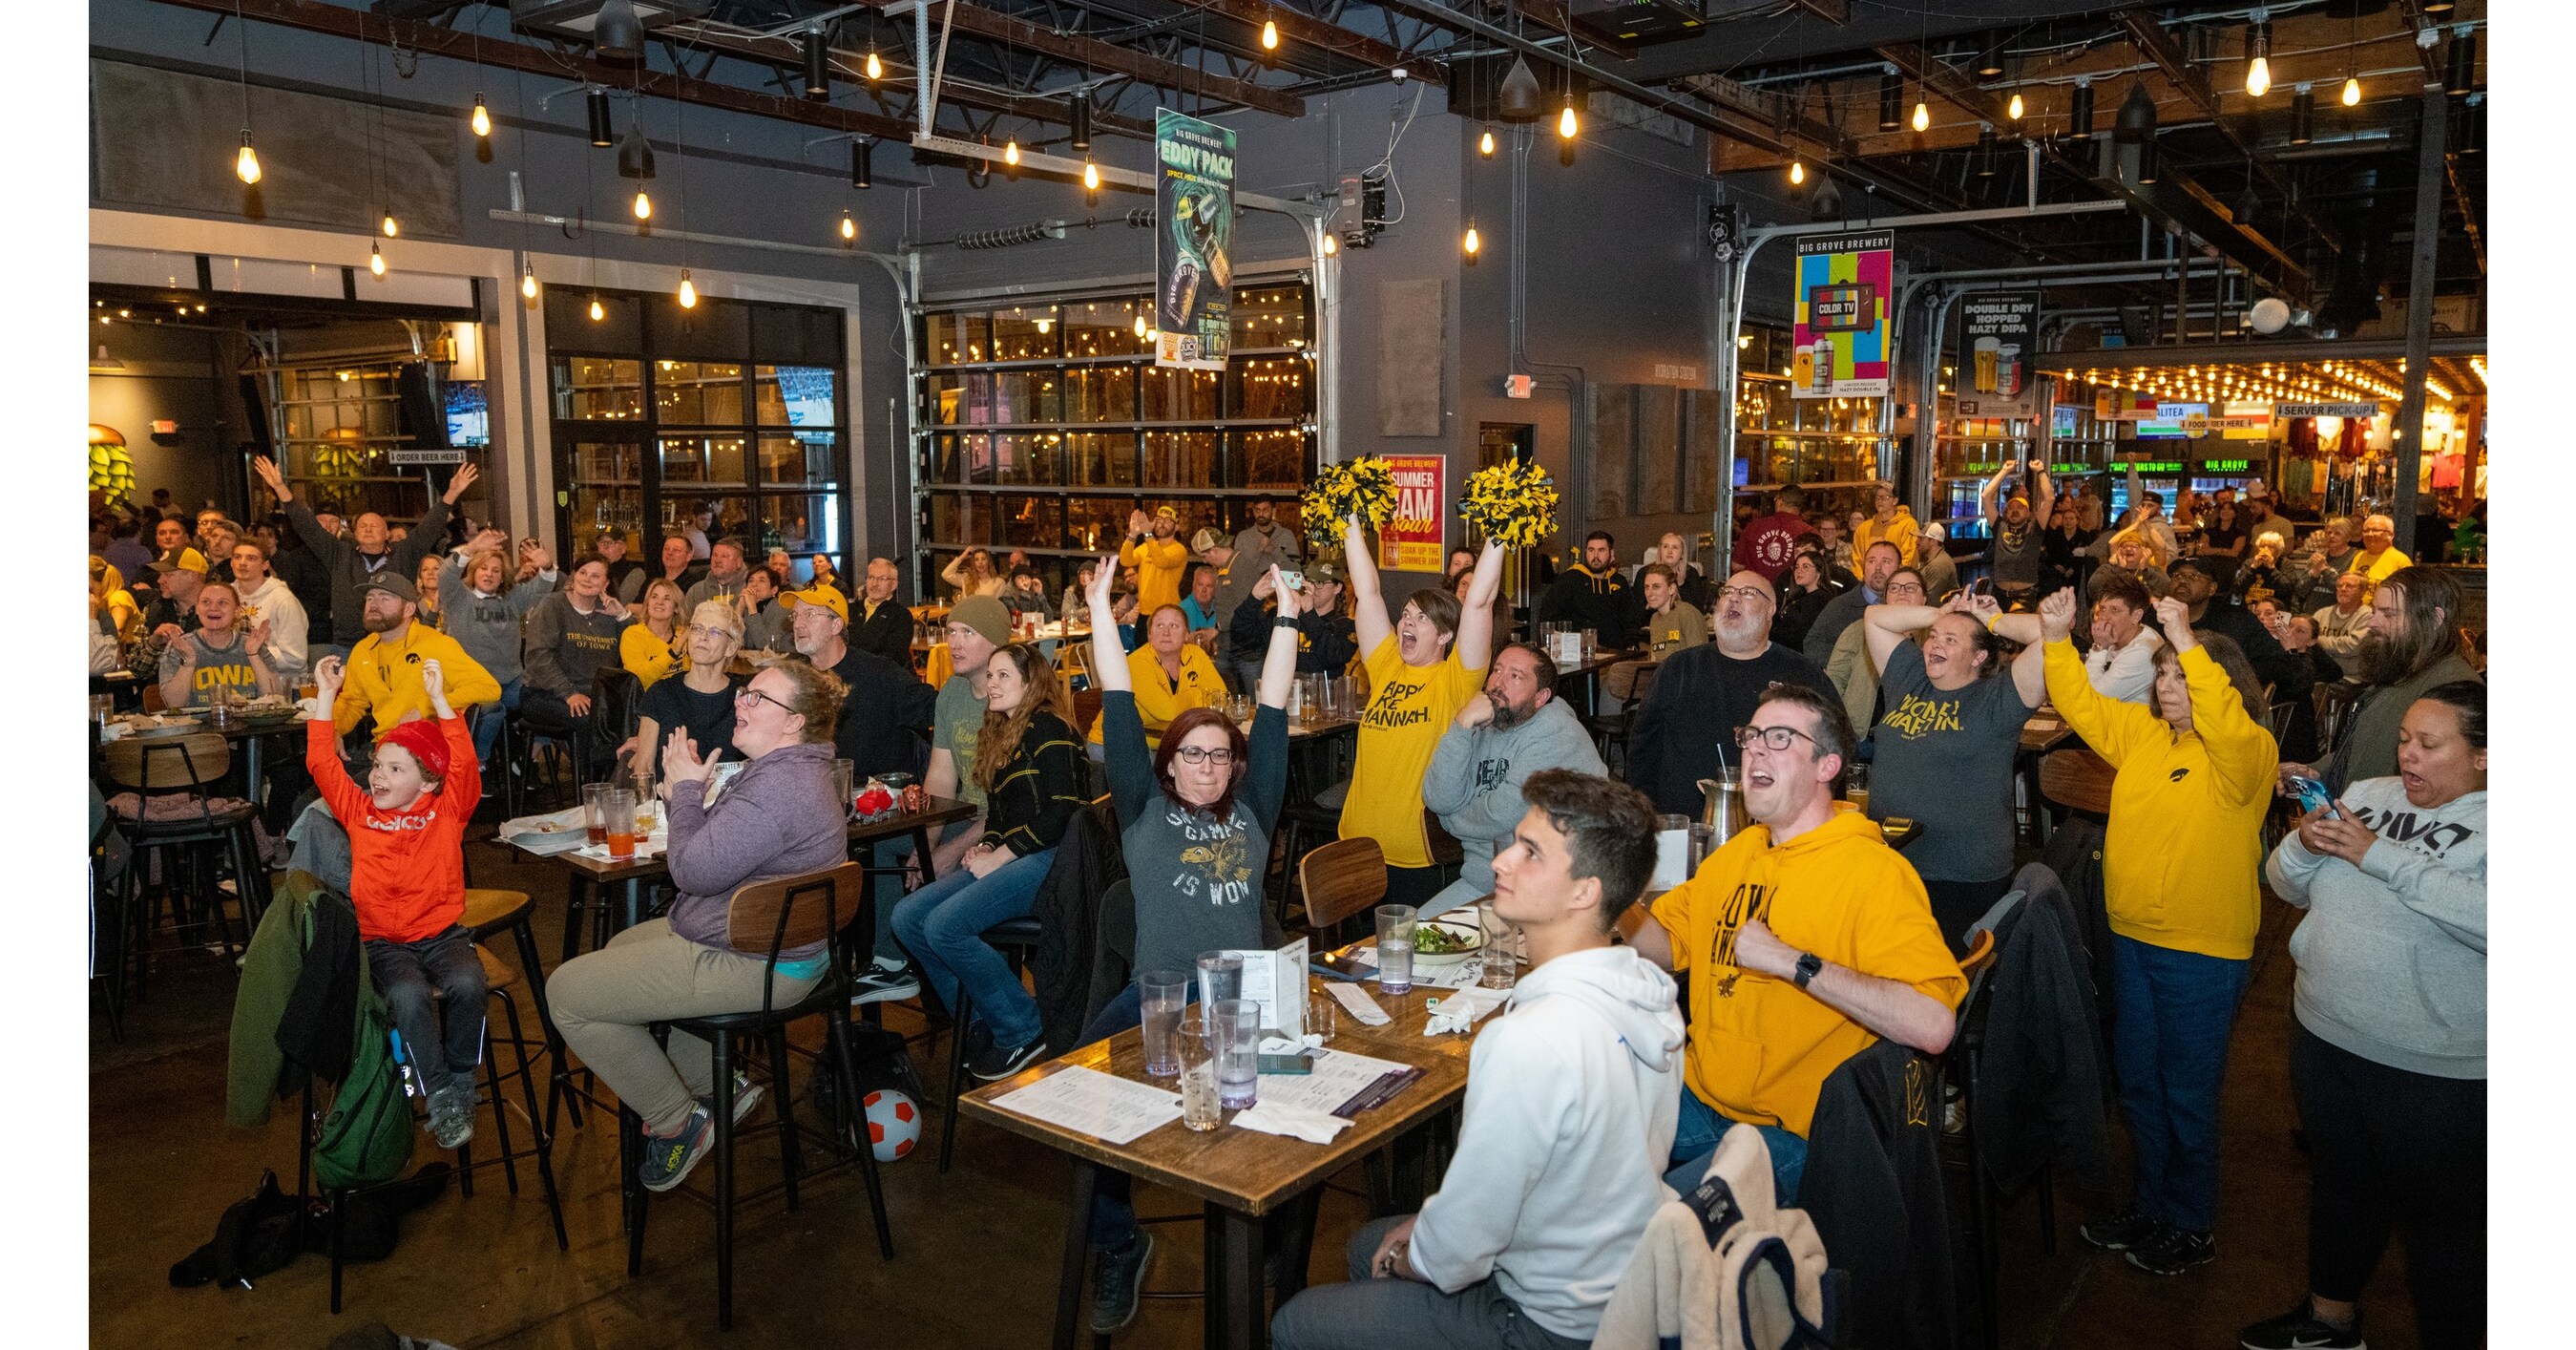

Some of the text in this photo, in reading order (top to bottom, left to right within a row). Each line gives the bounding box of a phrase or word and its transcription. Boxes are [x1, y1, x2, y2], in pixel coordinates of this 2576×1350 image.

[1175, 128, 1223, 150] BIG GROVE BREWERY
[1161, 138, 1234, 179] EDDY PACK
[1799, 237, 1890, 253] BIG GROVE BREWERY
[1818, 303, 1854, 314] COLOR TV
[1964, 303, 2035, 314] DOUBLE DRY
[1976, 313, 2021, 324] HOPPED
[1968, 324, 2028, 334] HAZY DIPA
[2156, 408, 2184, 417] ALITEA
[2284, 405, 2371, 415] SERVER PICK-UP
[2226, 419, 2244, 428] HERE
[396, 453, 458, 462] ORDER BEER HERE
[1414, 459, 1437, 468] BREWERY
[2206, 460, 2248, 469] BIG GROVE
[1392, 472, 1435, 487] SUMMER
[1400, 546, 1439, 556] SOAK UP THE
[1758, 530, 1780, 544] GROVE
[1780, 531, 1793, 563] BREWERY
[1400, 556, 1439, 566] SUMMER JAM
[567, 632, 581, 641] THE
[590, 641, 611, 650] IOWA
[195, 664, 256, 691] OWA
[1383, 681, 1426, 700] APPY
[1374, 695, 1403, 710] KE
[1184, 823, 1232, 841] GAME
[1172, 873, 1250, 907] IS WON
[665, 1144, 685, 1173] HOKA
